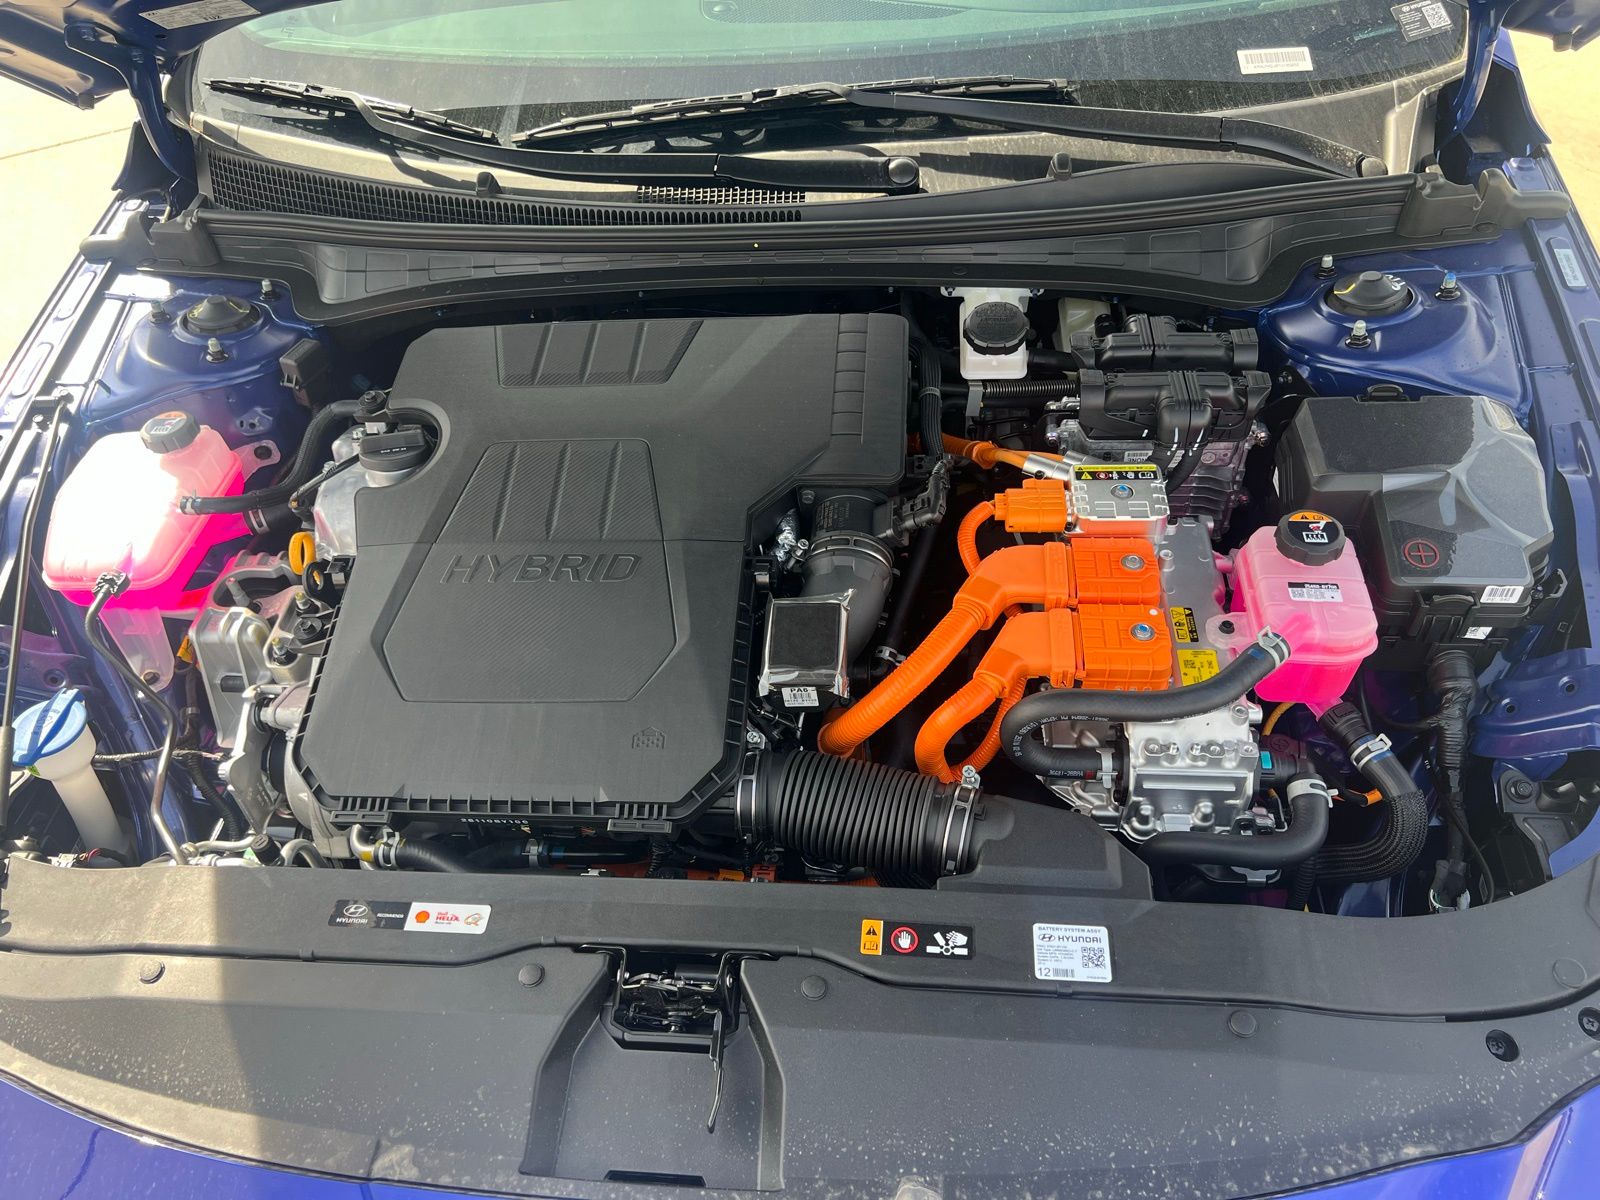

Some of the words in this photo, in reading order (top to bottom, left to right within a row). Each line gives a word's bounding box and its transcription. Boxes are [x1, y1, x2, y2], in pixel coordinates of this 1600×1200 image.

[440, 553, 641, 583] HYBRID
[1058, 935, 1102, 943] HYUNDAI
[1038, 968, 1051, 977] 12
